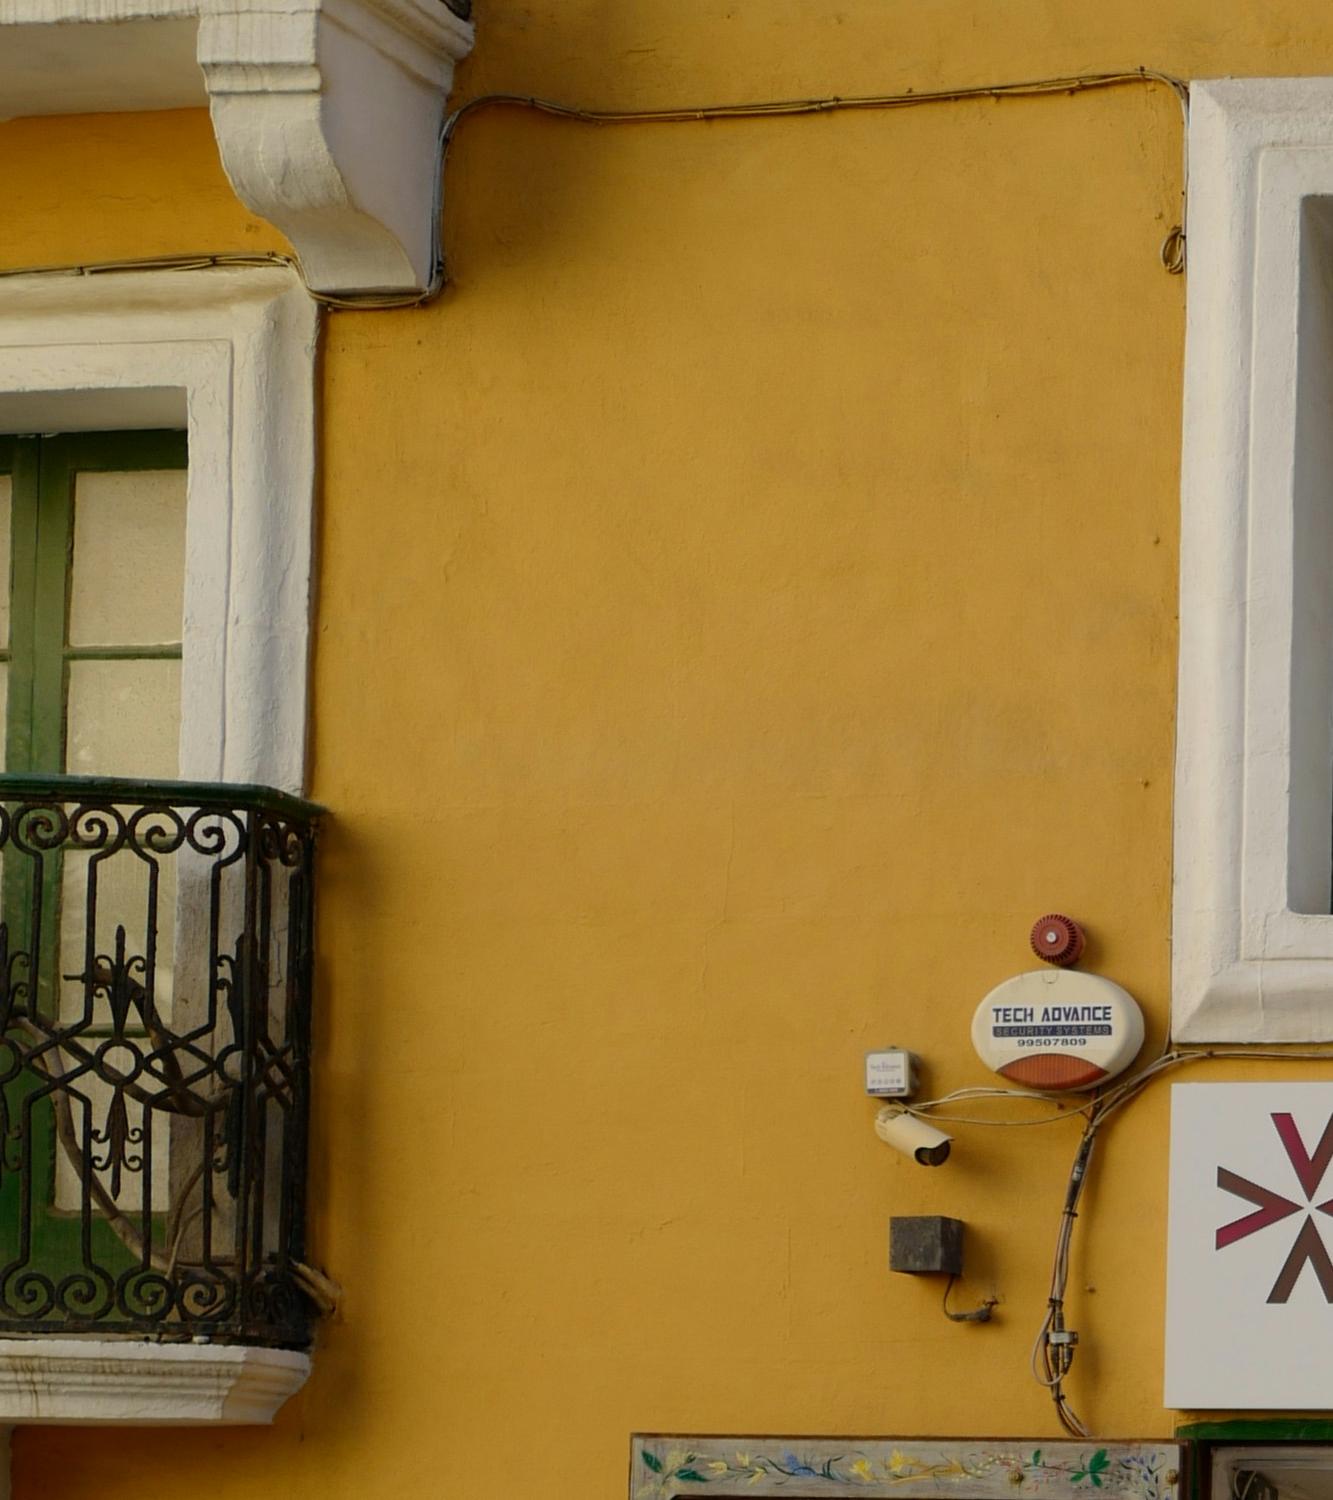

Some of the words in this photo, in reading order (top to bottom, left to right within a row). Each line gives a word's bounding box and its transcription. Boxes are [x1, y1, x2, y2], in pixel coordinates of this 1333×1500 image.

[992, 1007, 1034, 1023] TECH
[1041, 1006, 1112, 1022] ADVANCE
[995, 1026, 1052, 1037] SECURITY
[1055, 1025, 1109, 1036] SYSTEMS
[1017, 1038, 1087, 1047] 99507809
